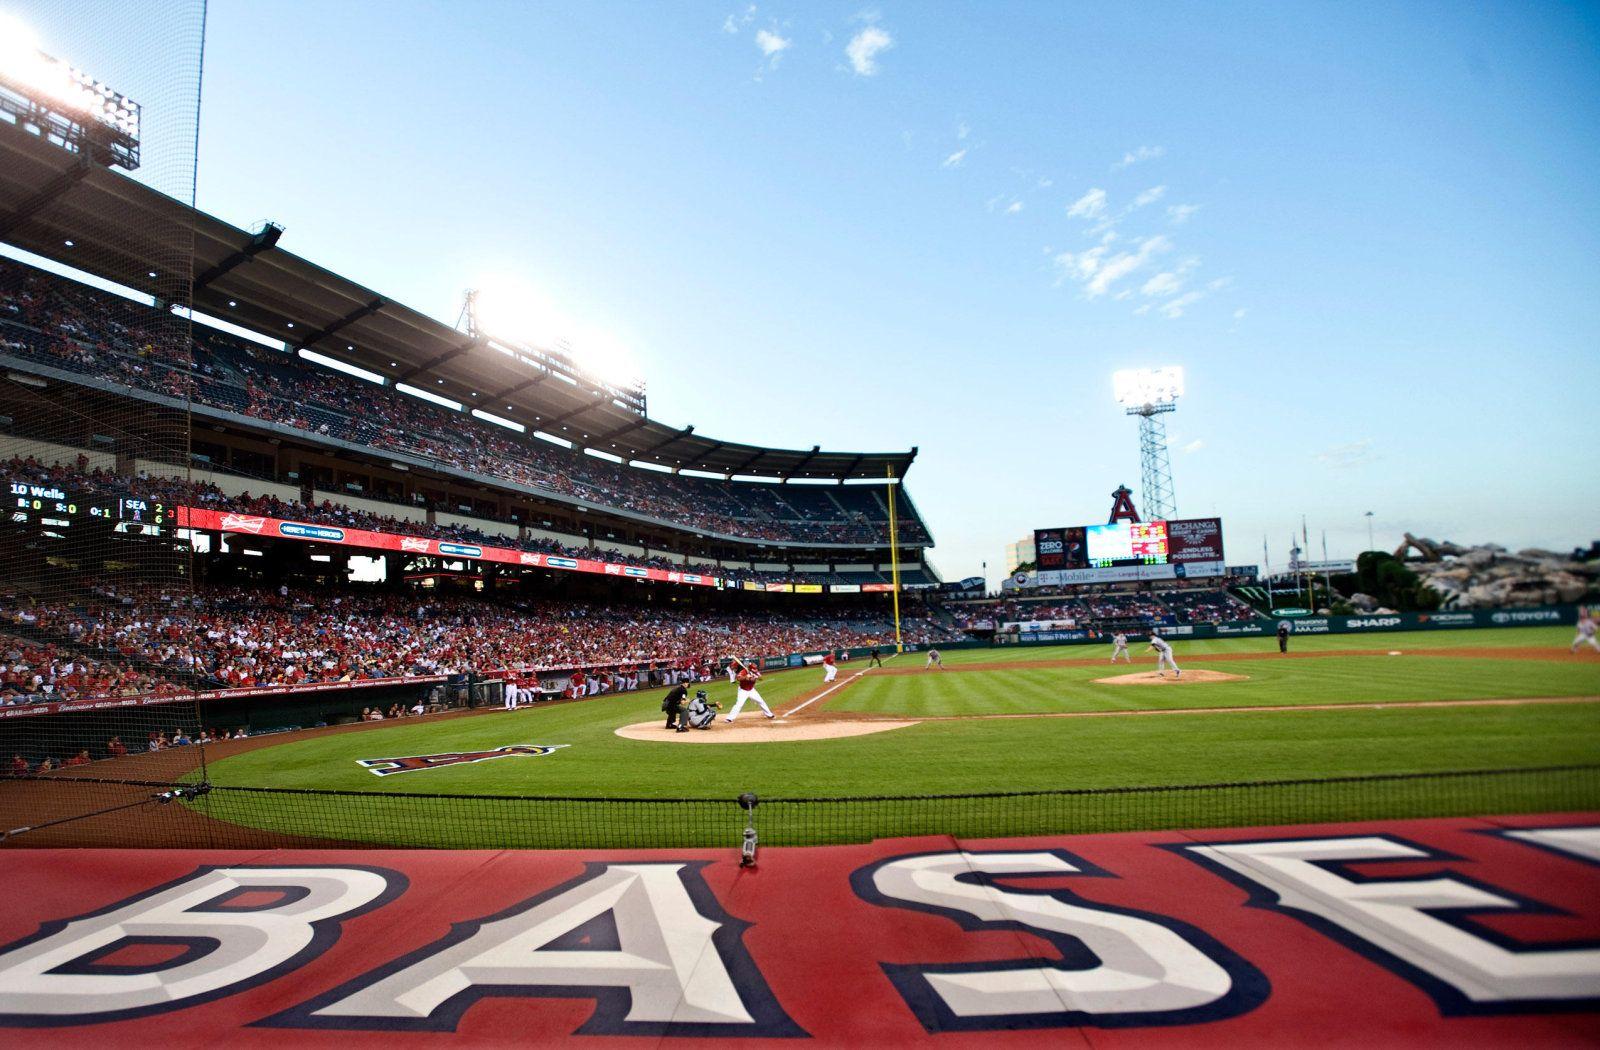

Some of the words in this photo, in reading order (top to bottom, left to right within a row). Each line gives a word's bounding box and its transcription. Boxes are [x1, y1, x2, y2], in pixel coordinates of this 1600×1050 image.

[10, 484, 27, 495] 10
[30, 486, 65, 500] Wells
[126, 500, 147, 510] SEA
[155, 503, 163, 513] 2
[155, 515, 163, 524] 6
[1040, 541, 1063, 549] ZERO
[1511, 611, 1560, 621] TOYOTA
[1346, 618, 1401, 628] SHARP
[1294, 625, 1329, 633] AAA.com
[0, 826, 1600, 1038] BASE
